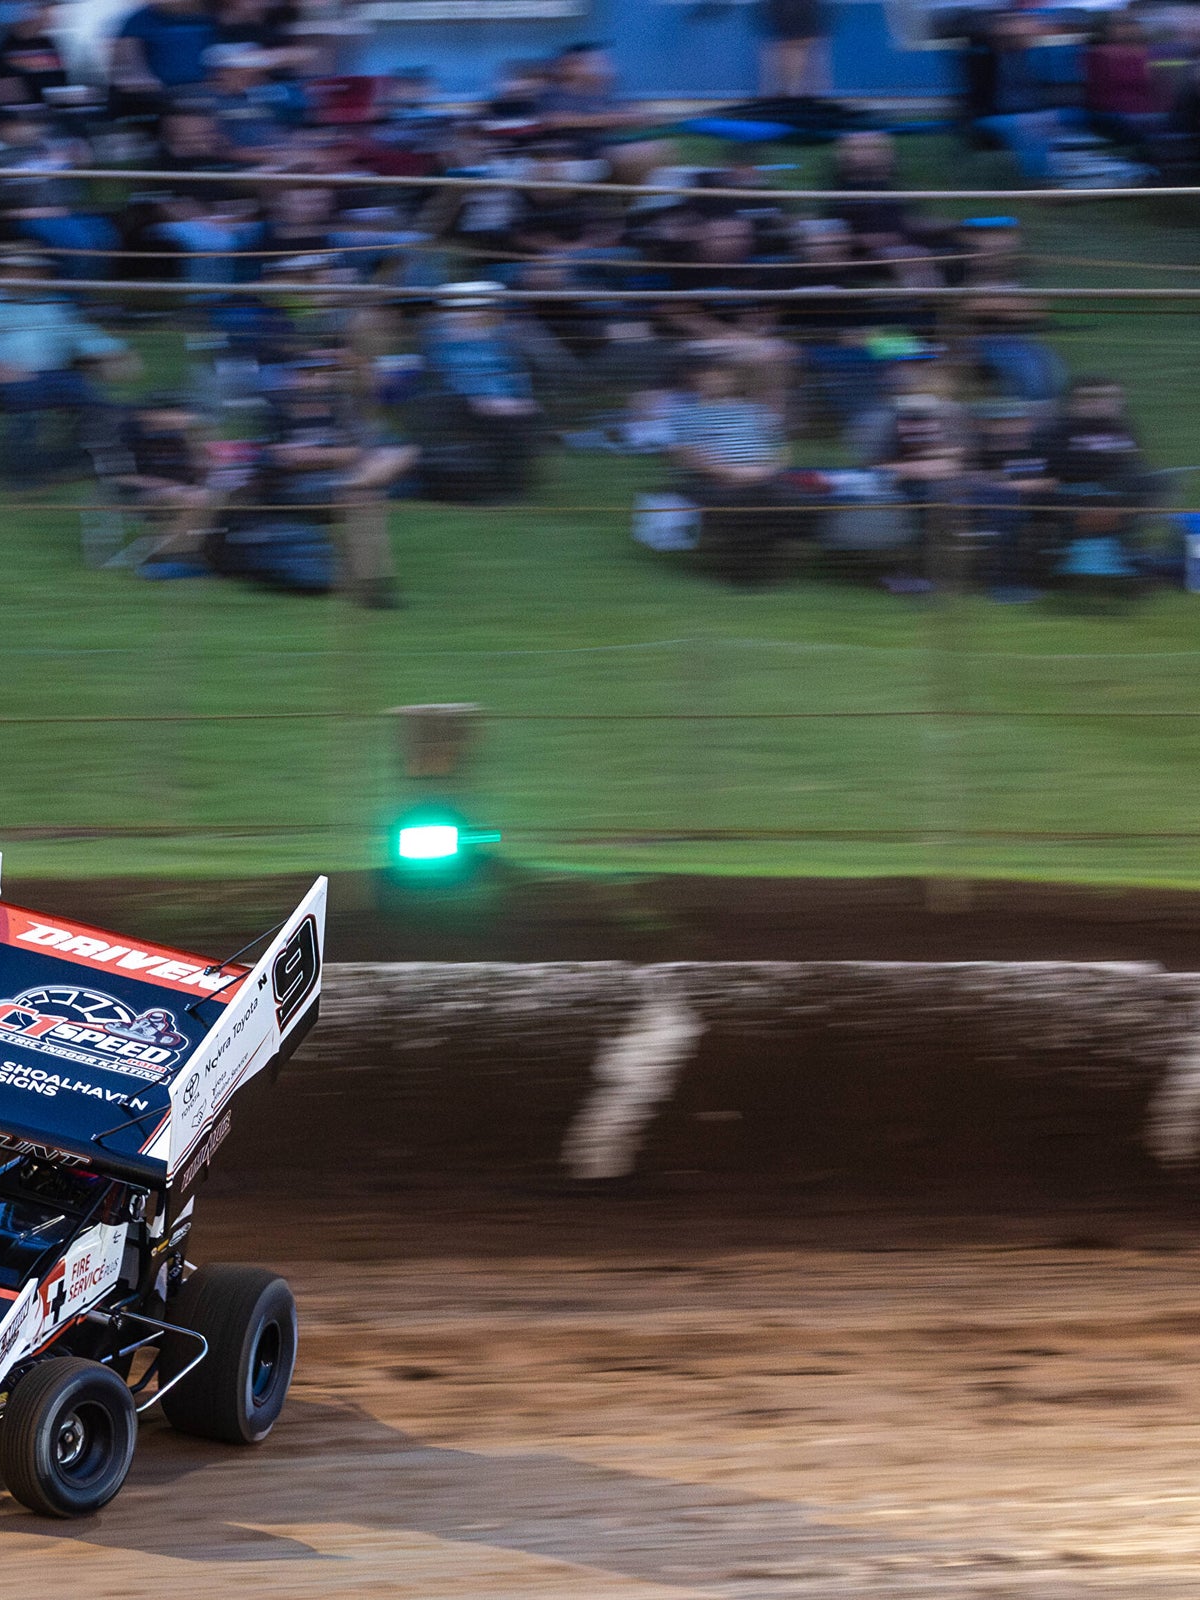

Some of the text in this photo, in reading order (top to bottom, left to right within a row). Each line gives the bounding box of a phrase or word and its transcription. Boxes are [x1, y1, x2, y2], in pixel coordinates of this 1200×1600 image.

[16, 920, 238, 994] DRIVEN
[272, 914, 320, 1035] 9
[233, 997, 259, 1040] Toyota
[43, 1044, 97, 1065] INDOOR
[98, 1059, 162, 1081] KARTING
[50, 1025, 173, 1064] SPEED
[68, 1264, 105, 1300] SERVICE
[71, 1253, 91, 1281] FIRE
